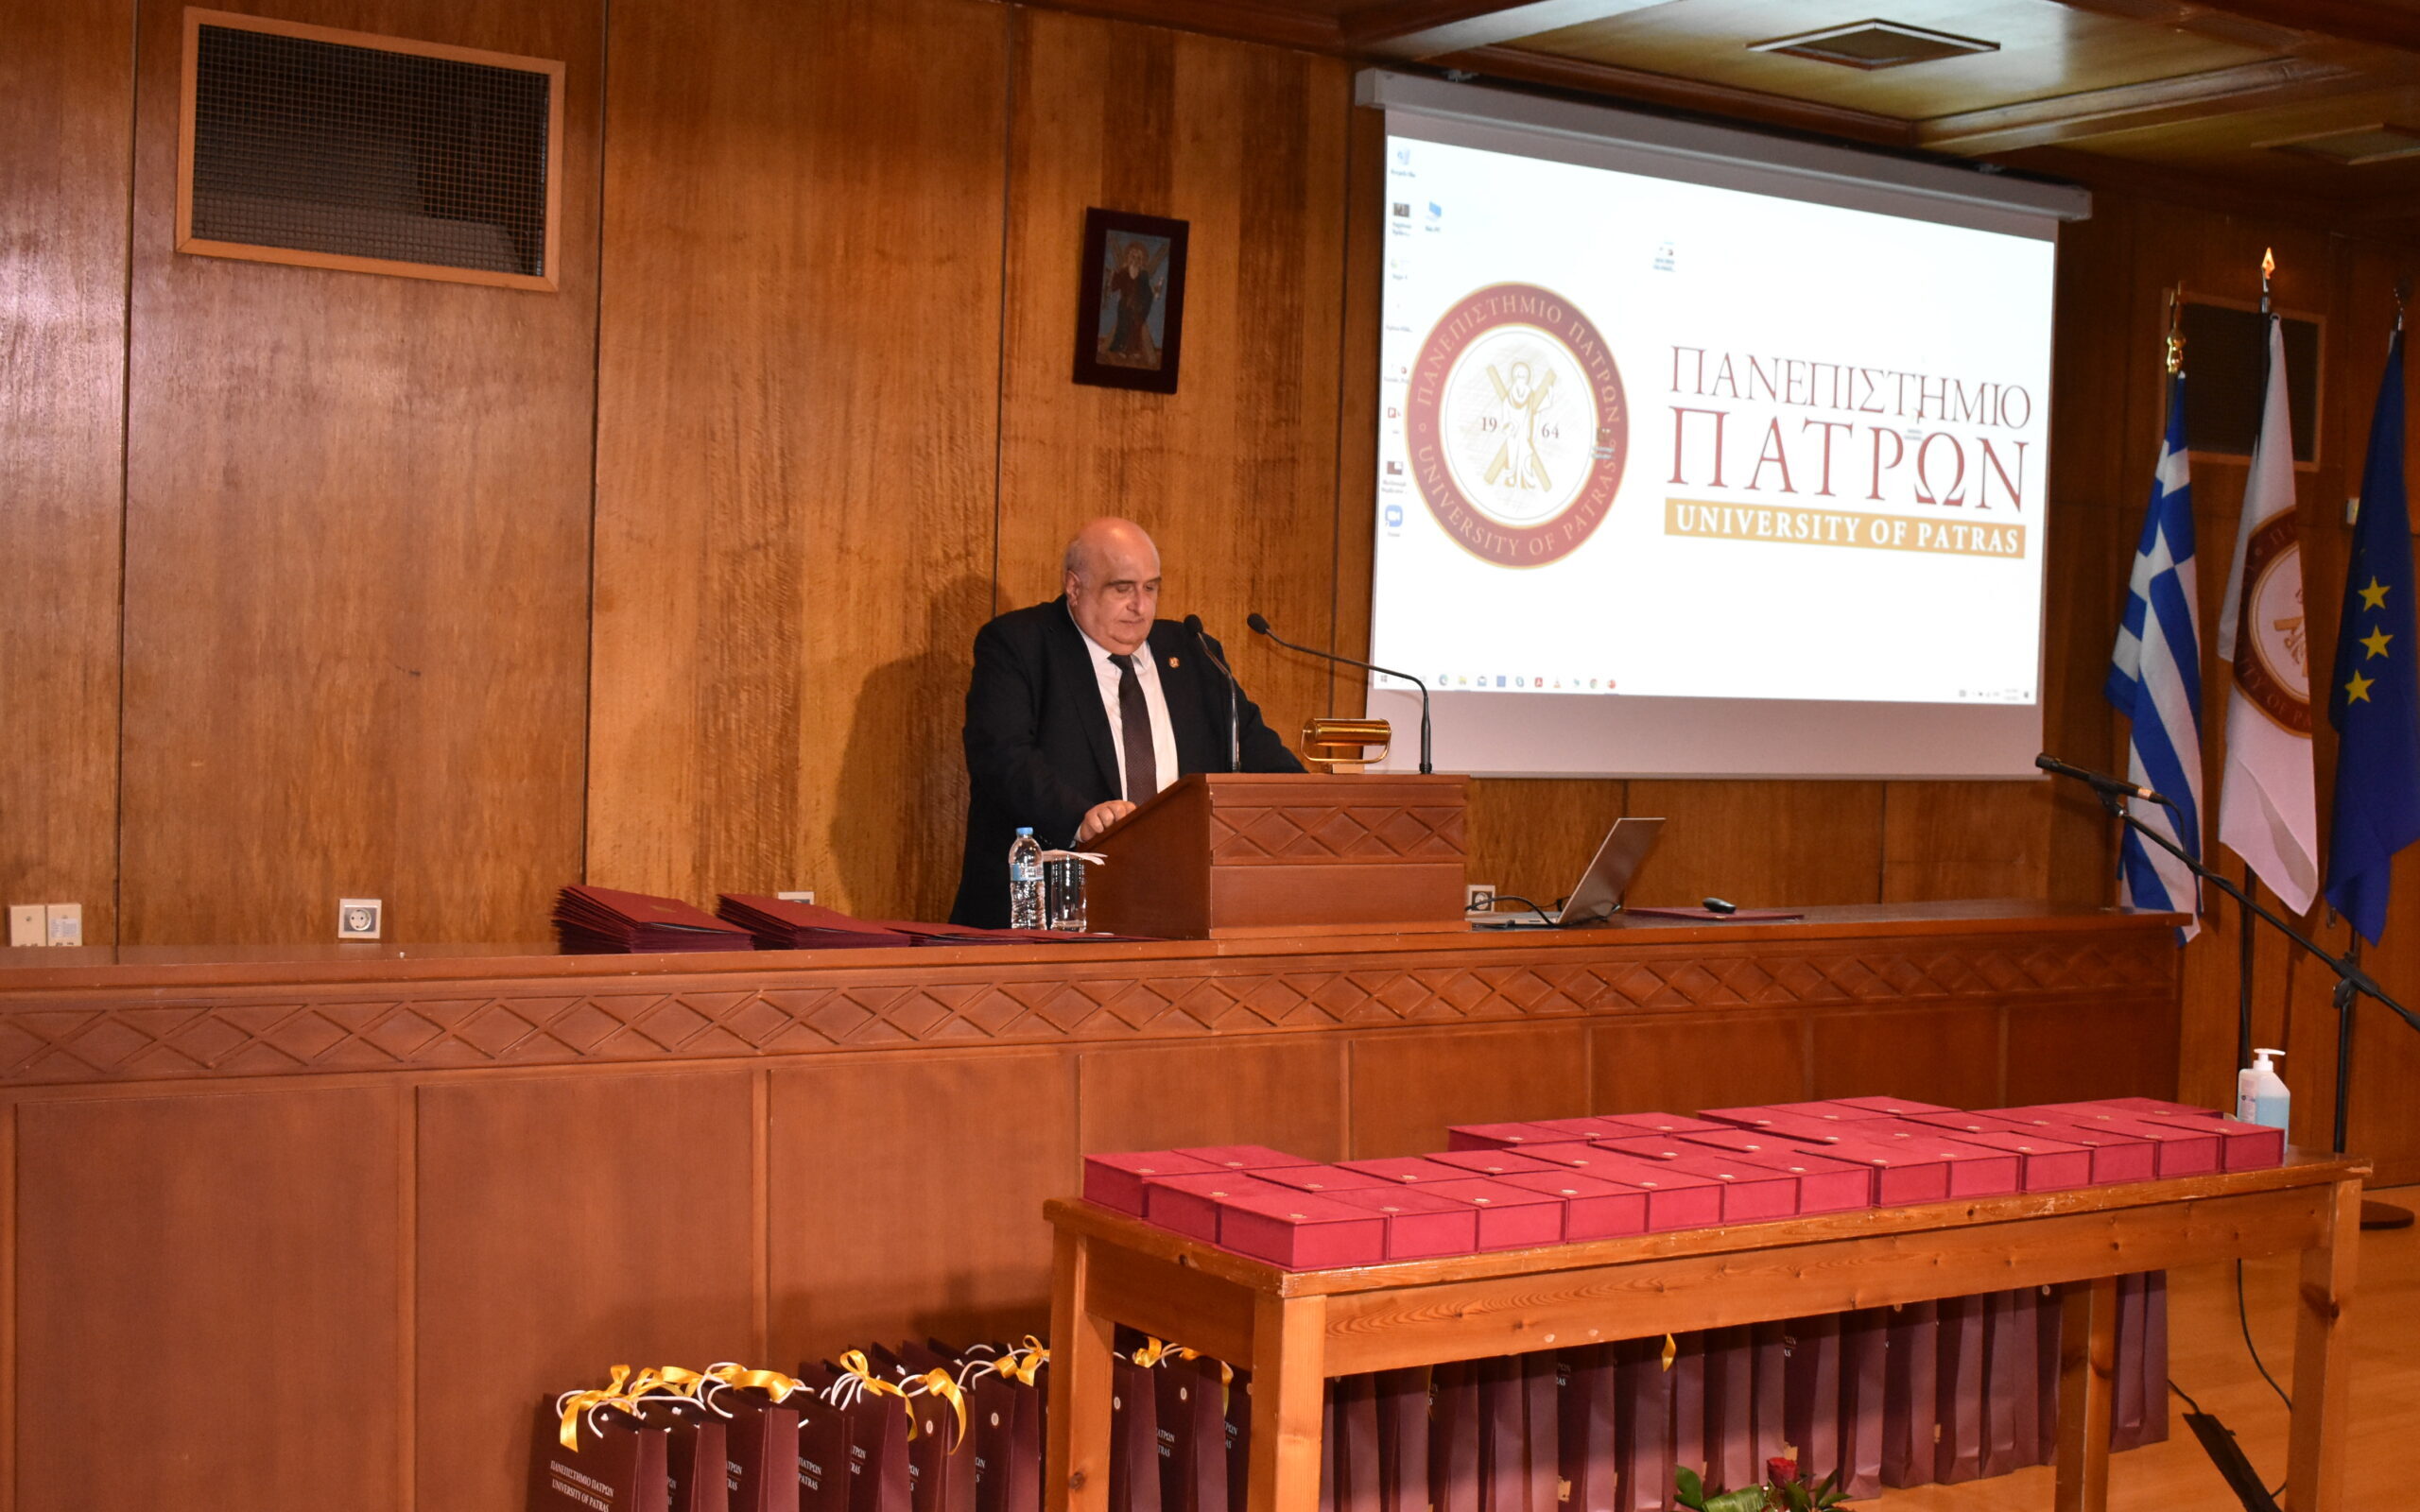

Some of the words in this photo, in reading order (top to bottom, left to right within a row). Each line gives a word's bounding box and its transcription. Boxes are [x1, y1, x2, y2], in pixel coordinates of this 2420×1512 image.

[1417, 294, 1562, 406] ΠΑΝΕΠΙΣΤΗΜΙΟ
[1568, 321, 1619, 423] ΠΑΤΡΩΝ
[1669, 344, 2031, 429] ΠΑΝΕΠΙΣΤΗΜΙΟ
[1481, 417, 1497, 433] 19
[1541, 423, 1560, 439] 64
[1667, 404, 2030, 513] ΠΑΤΡΩΝ
[1419, 444, 1519, 556] UNIVERSITY
[1529, 532, 1555, 556] OF
[1563, 459, 1616, 541] PATRAS
[1675, 504, 1860, 543] UNIVERSITY
[1870, 519, 1907, 546] OF
[1917, 523, 2018, 554] PATRAS
[1157, 1428, 1175, 1443] ΑΤΡΩΝ
[550, 1460, 591, 1487] ΠΑΝΕΠΙΣΤΗΜΙΟ
[591, 1479, 614, 1498] ΠΑΤΡΩΝ
[552, 1478, 582, 1501] UNIVERSITY
[581, 1493, 589, 1503] OF
[589, 1497, 610, 1512] PATRAS
